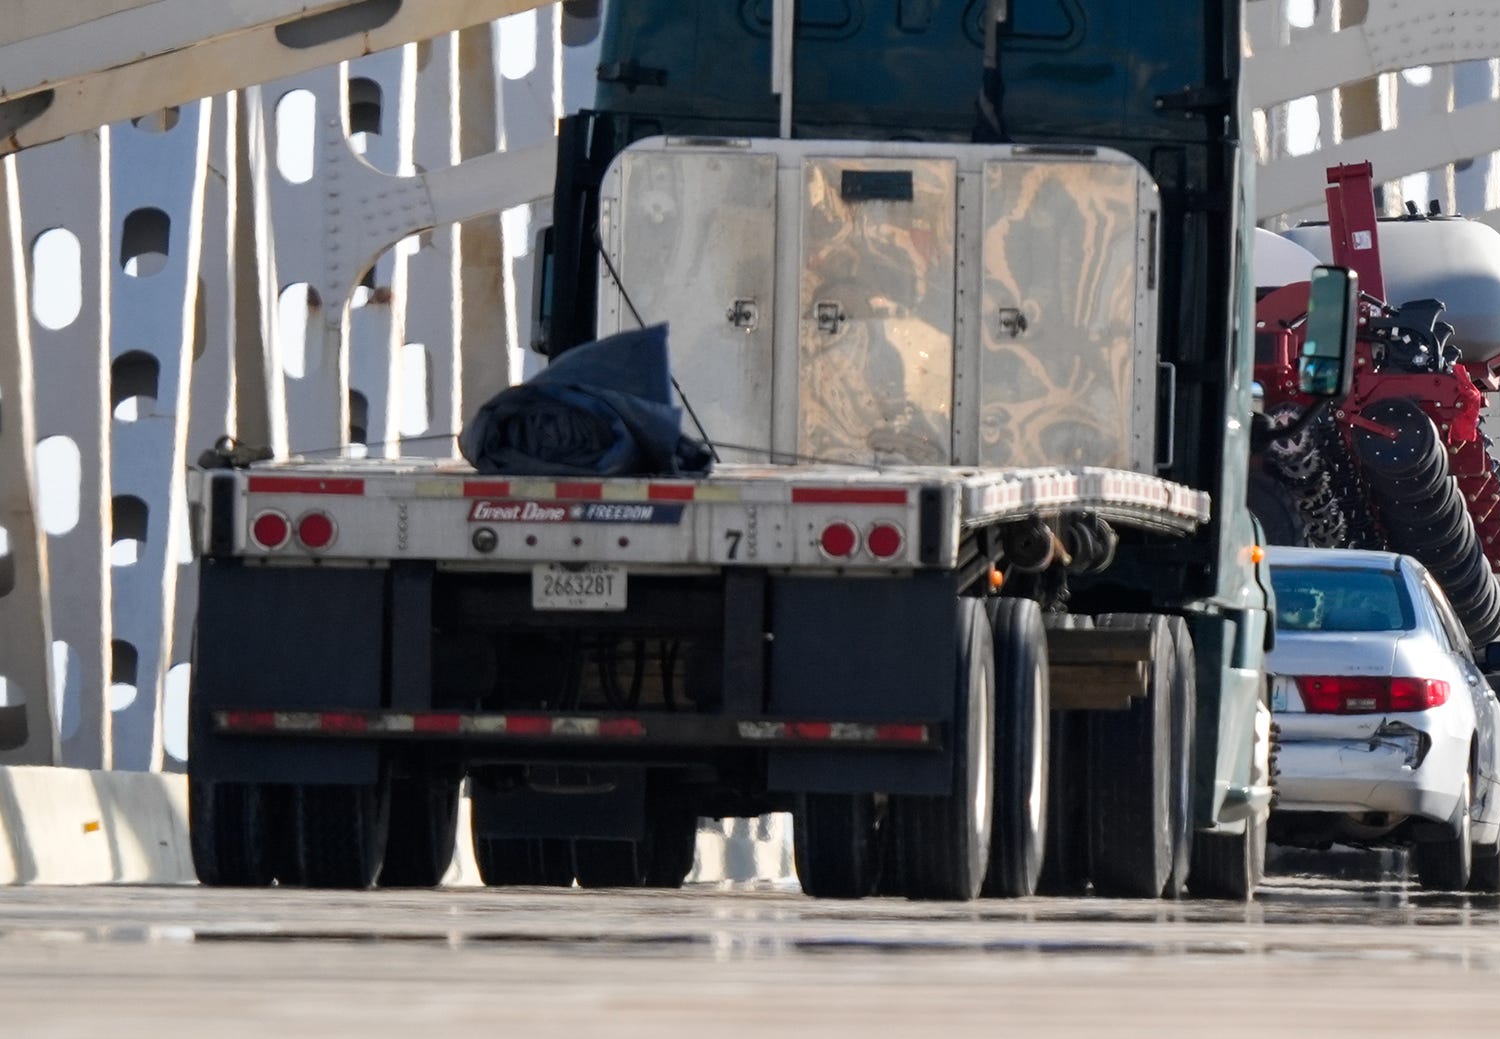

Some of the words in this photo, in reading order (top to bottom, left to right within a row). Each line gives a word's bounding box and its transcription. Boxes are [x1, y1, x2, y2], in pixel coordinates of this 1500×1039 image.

[474, 501, 518, 520] Great
[519, 501, 565, 521] Dane
[586, 505, 653, 520] FREEDOM
[725, 528, 743, 559] 7
